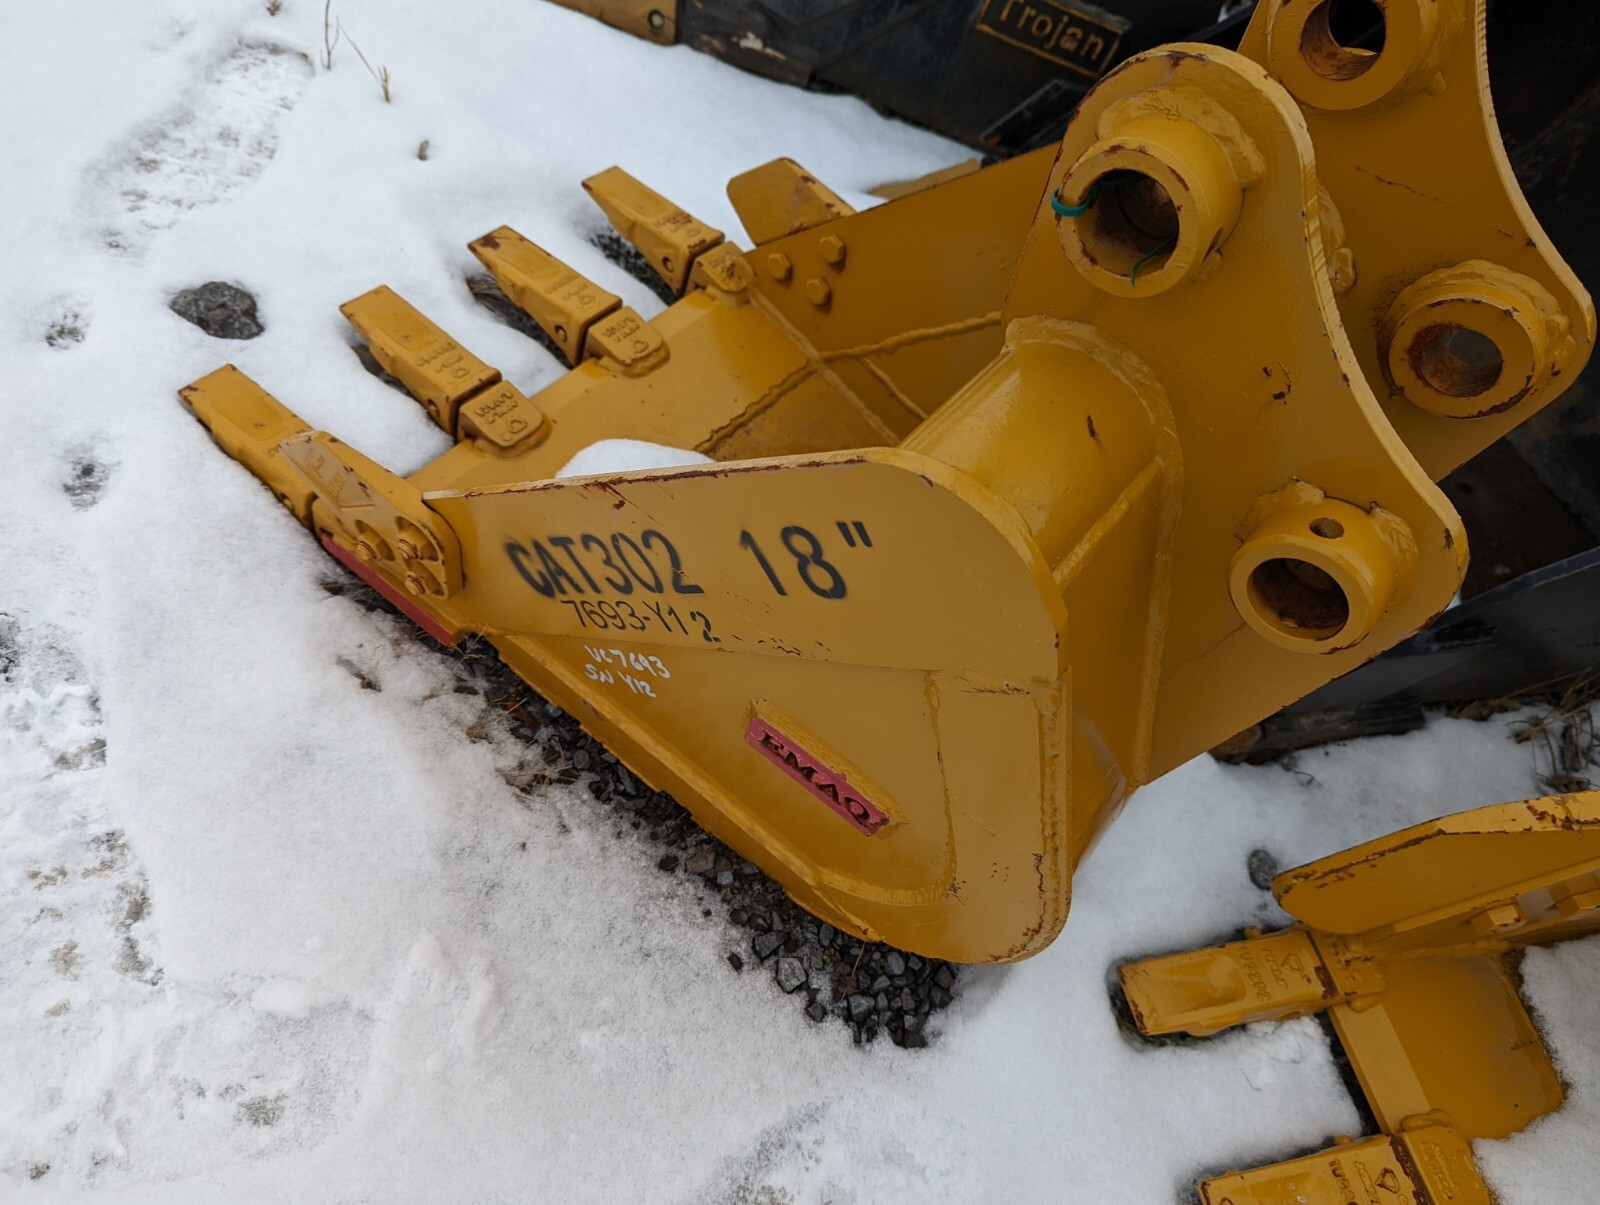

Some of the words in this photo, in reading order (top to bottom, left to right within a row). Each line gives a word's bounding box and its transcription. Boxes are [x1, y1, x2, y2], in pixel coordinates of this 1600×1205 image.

[503, 527, 705, 600] CAT302
[584, 663, 615, 685] SN
[757, 729, 874, 829] EMAQ
